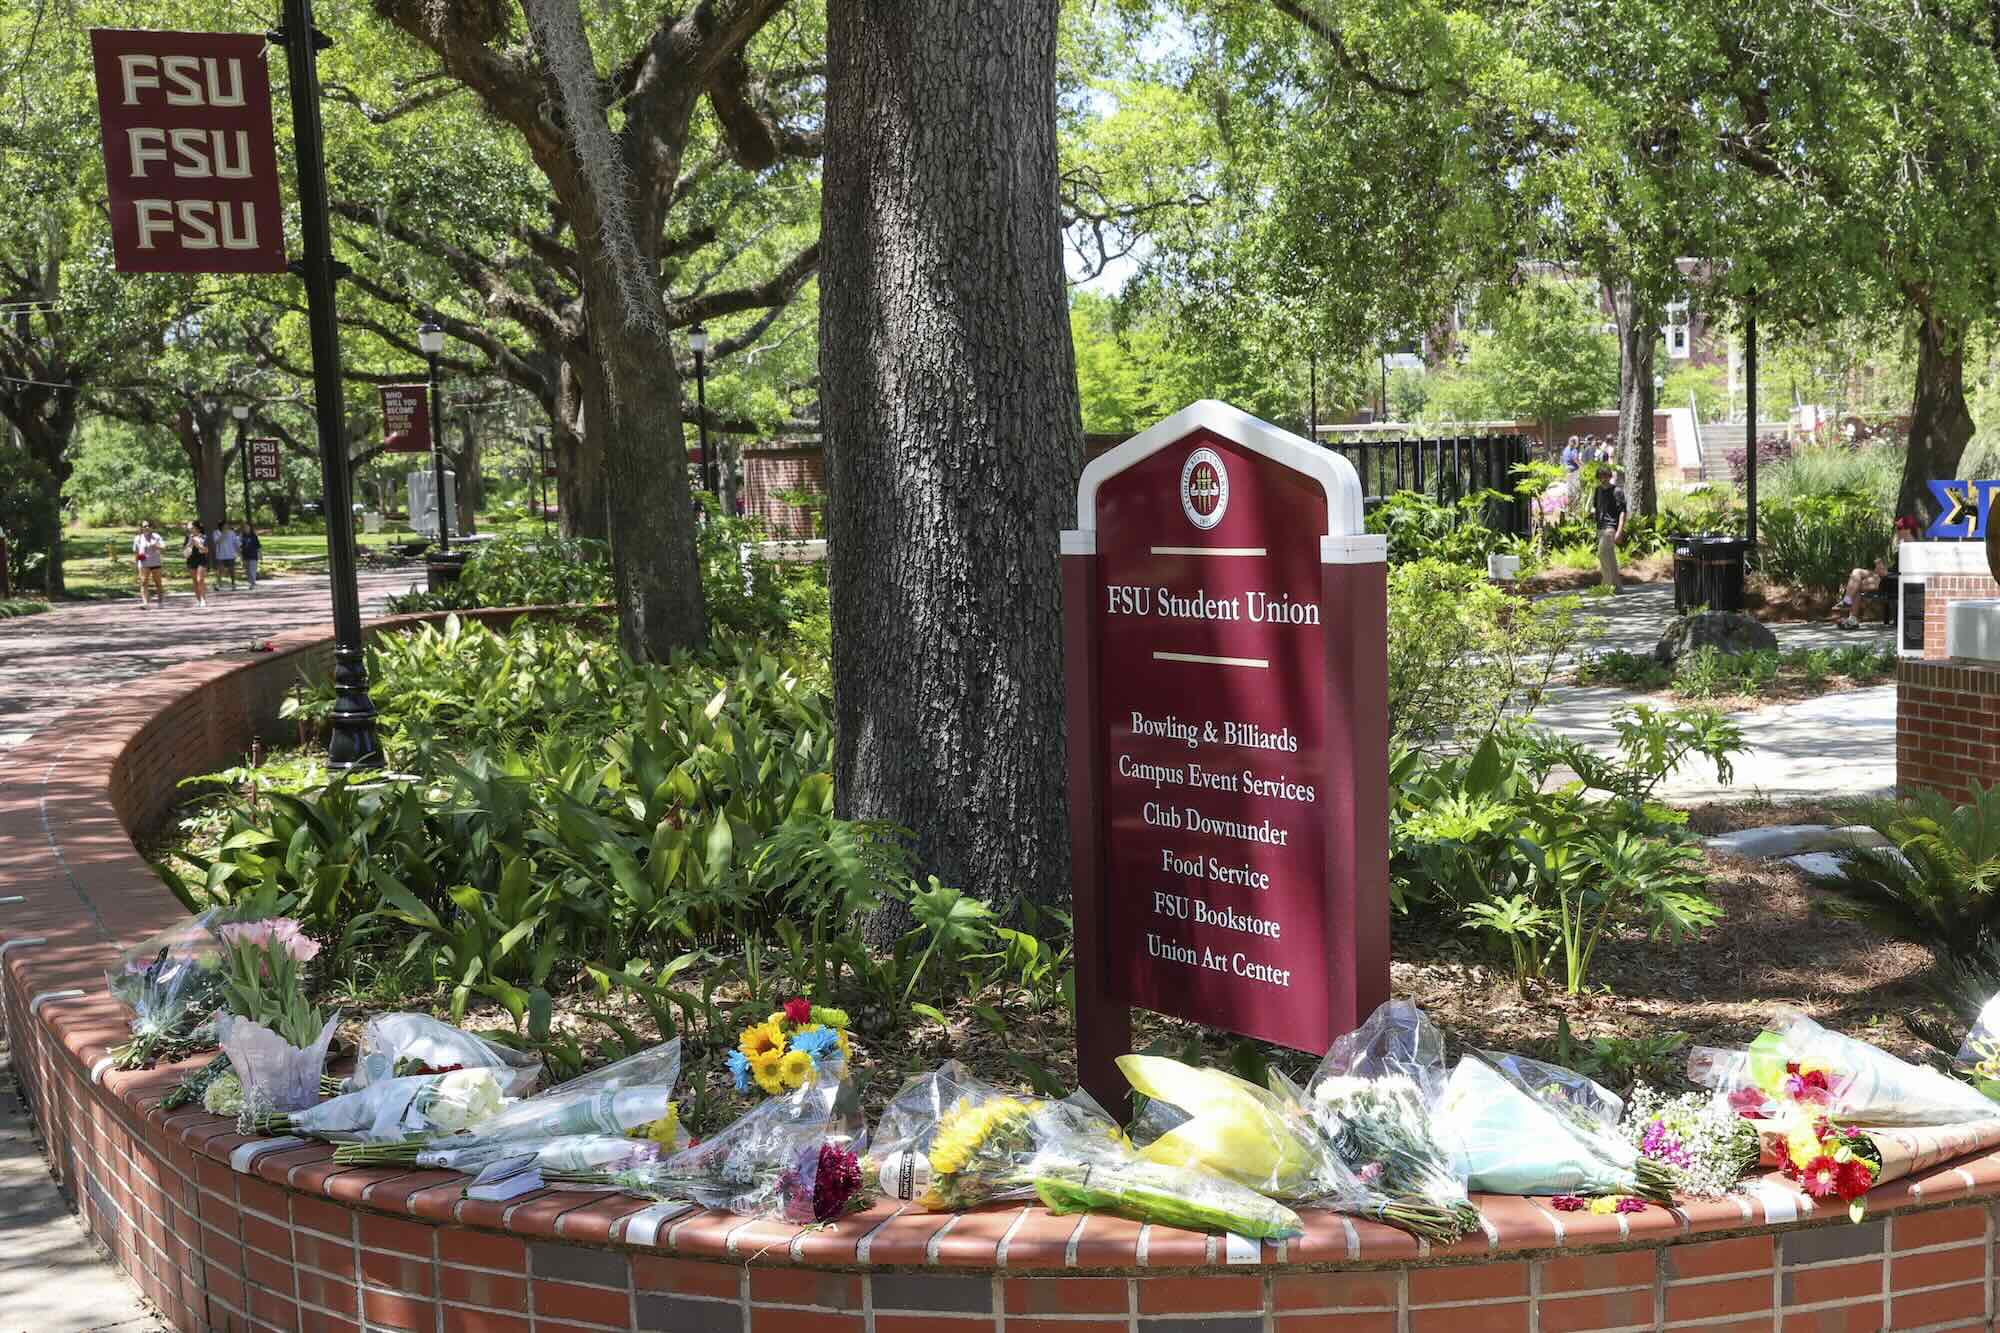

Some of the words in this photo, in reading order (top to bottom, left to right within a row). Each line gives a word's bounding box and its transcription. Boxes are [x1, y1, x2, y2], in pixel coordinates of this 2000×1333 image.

[118, 54, 248, 108] FSU
[126, 127, 254, 179] FSU
[133, 199, 260, 250] FSU
[253, 442, 274, 453] FSU
[254, 455, 275, 465] FSU
[255, 468, 276, 478] FSU
[1107, 585, 1151, 616] FSU
[1157, 587, 1240, 621] Student
[1245, 591, 1320, 625] Union
[1131, 711, 1198, 749] Bowling
[1203, 720, 1219, 744] &
[1224, 721, 1298, 753] Billiards
[1119, 754, 1184, 789] Campus
[1188, 763, 1239, 792] Event
[1243, 770, 1315, 803] Services
[1143, 801, 1181, 829] Club
[1186, 808, 1288, 846] Downunder
[1162, 848, 1204, 878] Food
[1209, 857, 1270, 890] Service
[1154, 890, 1189, 920] FSU
[1194, 899, 1281, 939] Bookstore
[1147, 933, 1198, 966] Union
[1201, 946, 1229, 973] Art
[1232, 952, 1291, 987] Center
